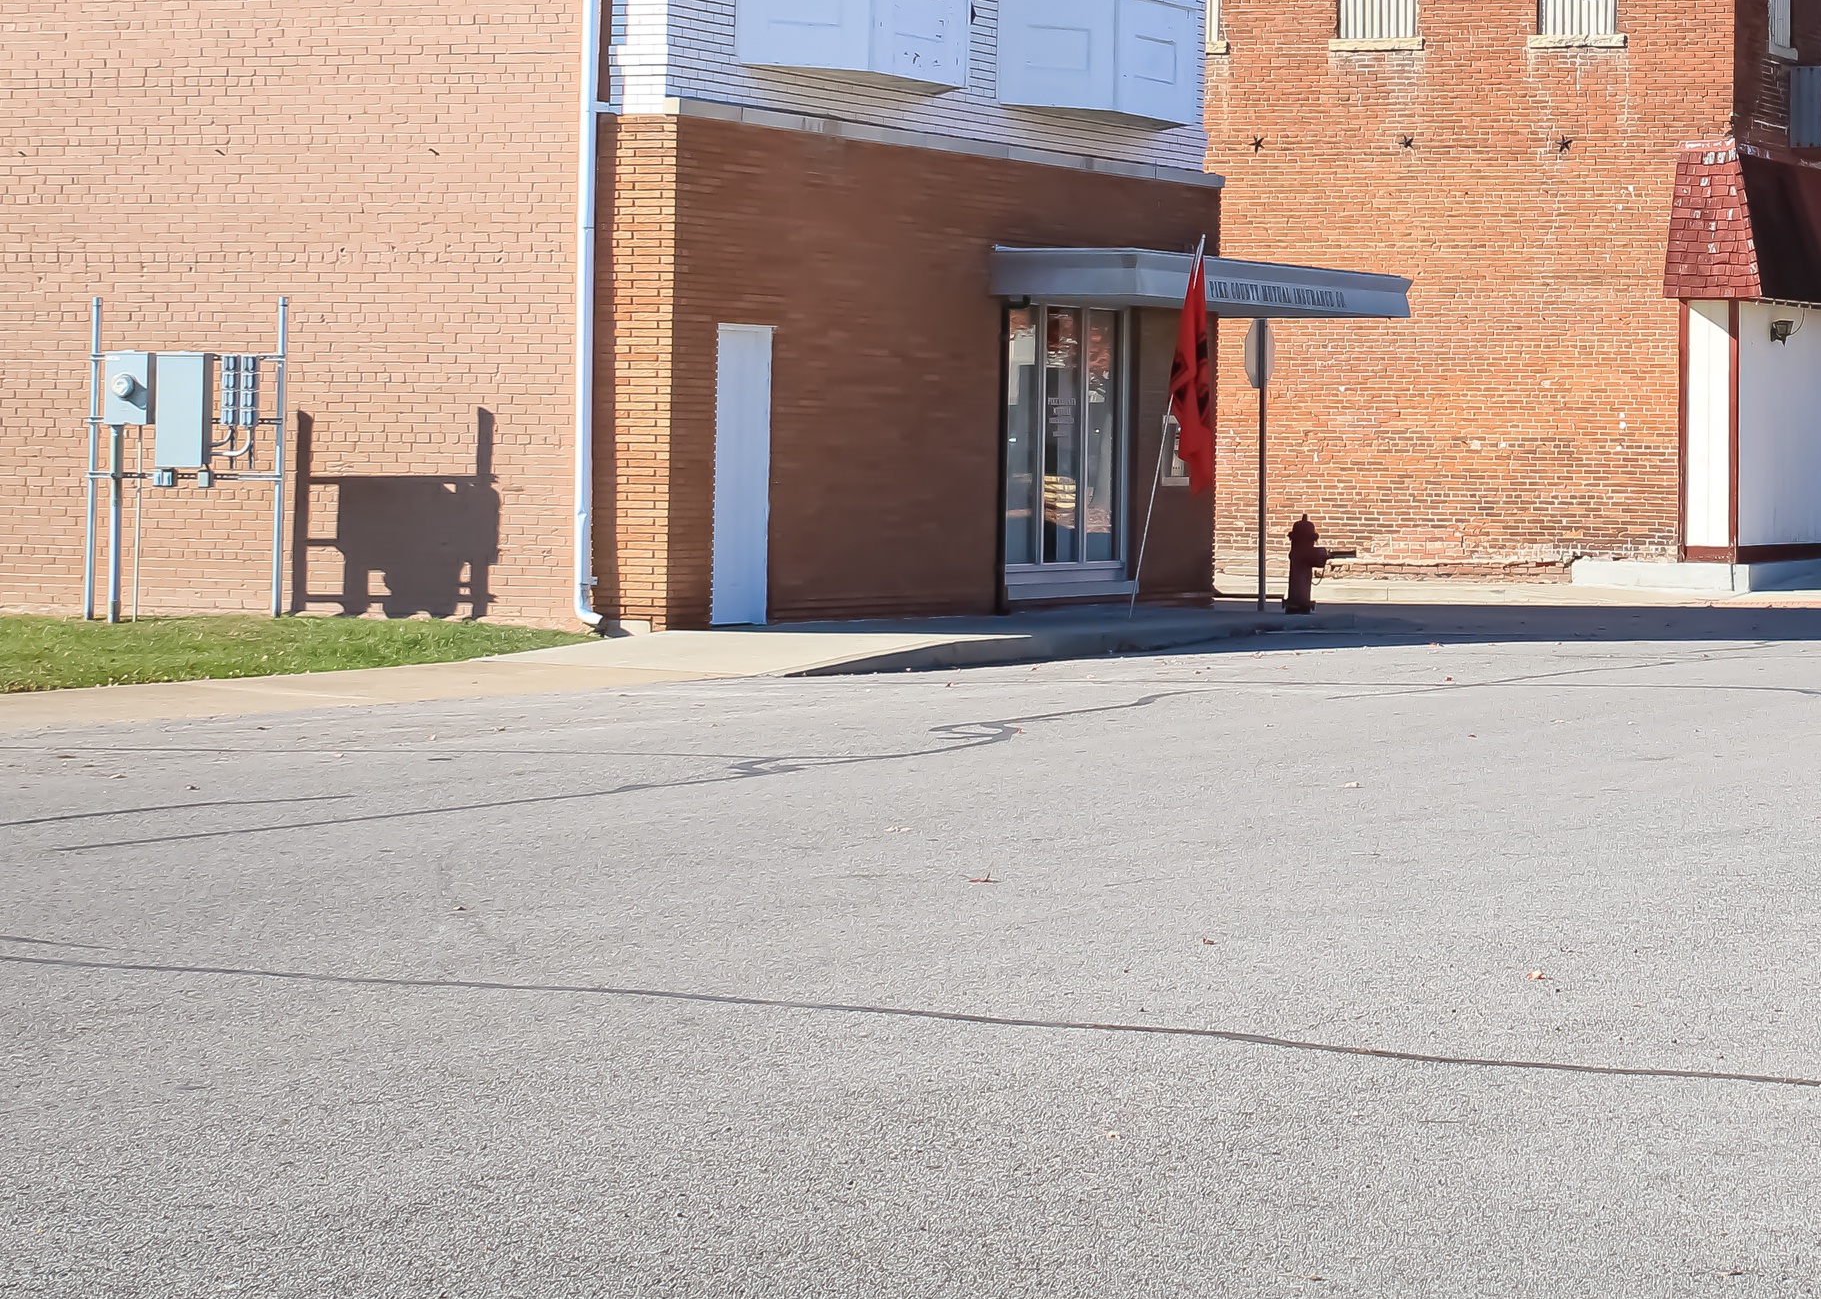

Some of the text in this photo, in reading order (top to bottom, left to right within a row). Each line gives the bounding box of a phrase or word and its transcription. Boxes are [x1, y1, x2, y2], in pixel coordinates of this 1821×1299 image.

[1209, 280, 1229, 299] PIKE
[1230, 282, 1260, 301] COUNTY
[1260, 285, 1292, 304] MUTUAL
[1292, 287, 1335, 307] INSURANCE
